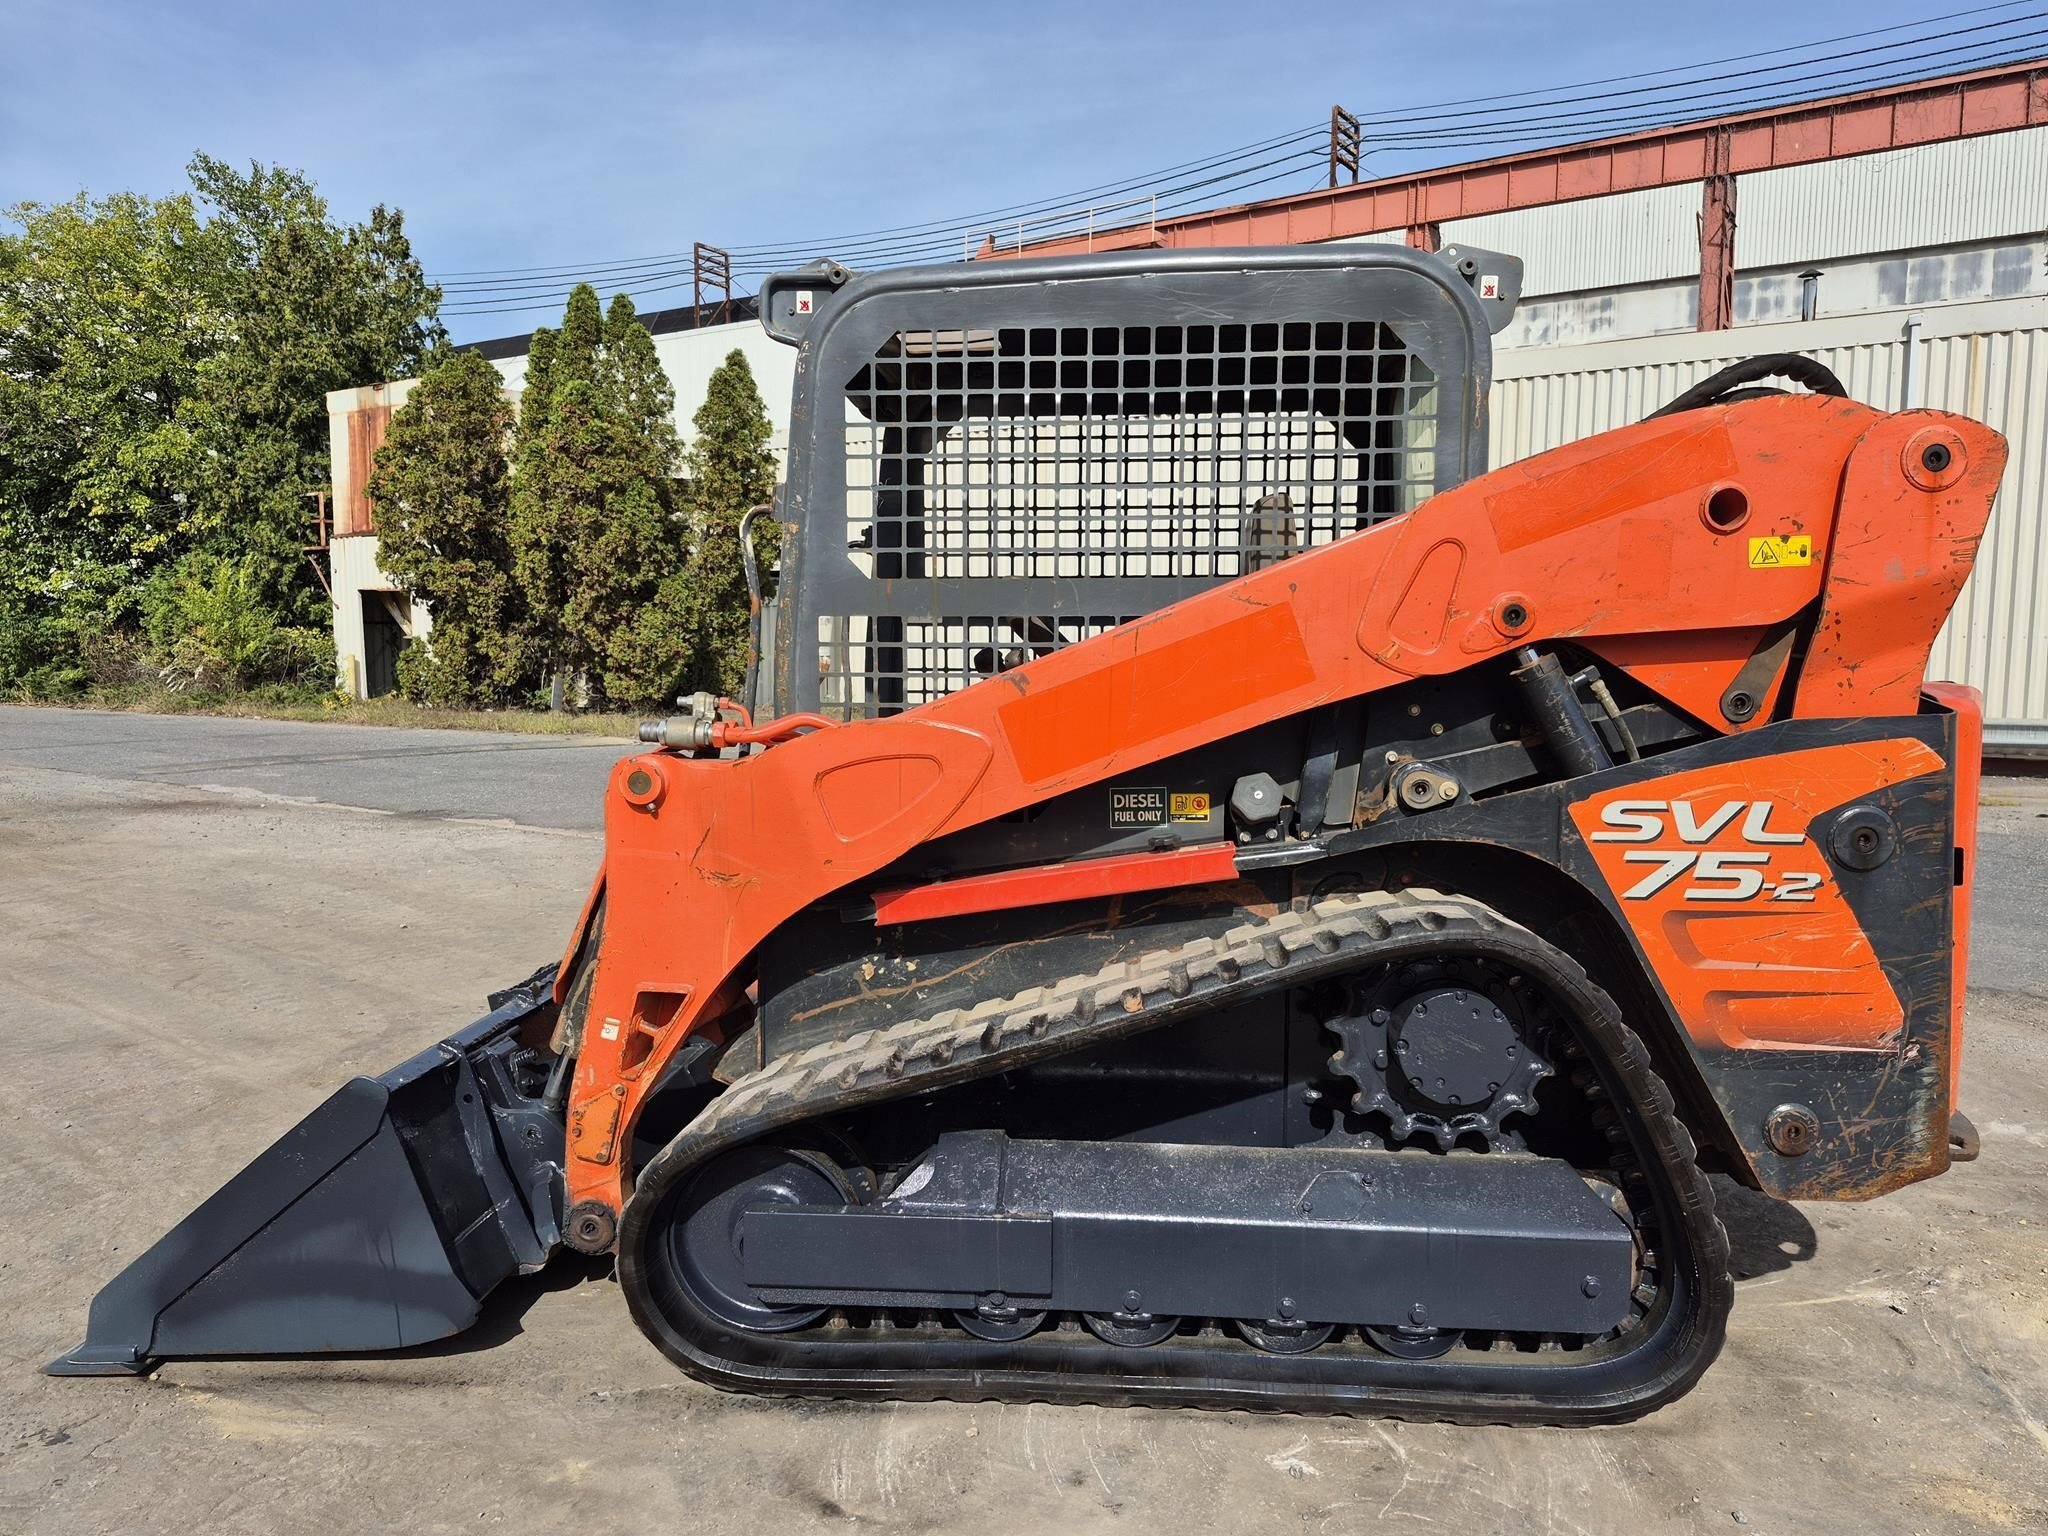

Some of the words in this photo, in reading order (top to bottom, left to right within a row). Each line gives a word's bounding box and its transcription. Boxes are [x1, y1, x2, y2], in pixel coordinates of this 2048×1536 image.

[1113, 794, 1163, 808] DIESEL
[1114, 811, 1136, 822] FUEL
[1137, 810, 1162, 822] ONLY
[1590, 800, 1807, 844] SVL
[1620, 850, 1823, 902] 75-2
